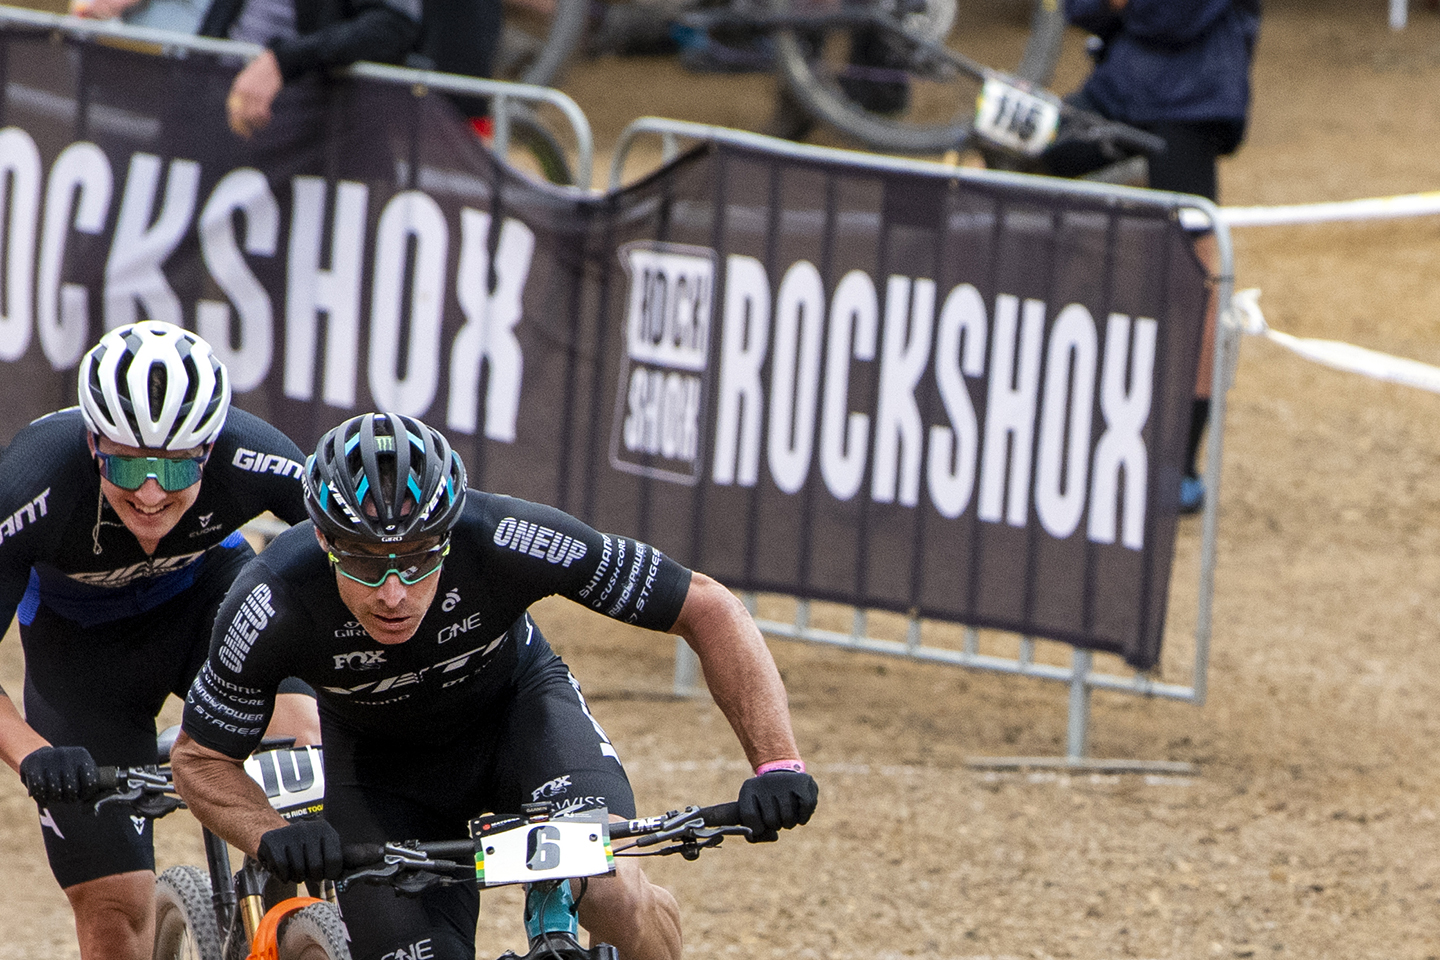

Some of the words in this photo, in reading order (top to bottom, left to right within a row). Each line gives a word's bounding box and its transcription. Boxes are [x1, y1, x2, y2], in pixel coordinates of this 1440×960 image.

[641, 267, 708, 350] ROCK
[712, 254, 1158, 551] ROCKSHOX
[232, 447, 304, 480] GIAN
[327, 480, 361, 524] YETI
[381, 535, 403, 543] GIRO
[493, 516, 588, 568] ONEUP
[601, 567, 620, 601] CUSH
[636, 547, 662, 611] STAGES
[218, 582, 276, 674] ONEUP
[332, 650, 388, 671] FOX
[194, 704, 263, 736] STAGES
[532, 775, 572, 802] FOX
[550, 796, 606, 812] WISS
[291, 807, 308, 817] RIDE
[526, 825, 561, 871] 6
